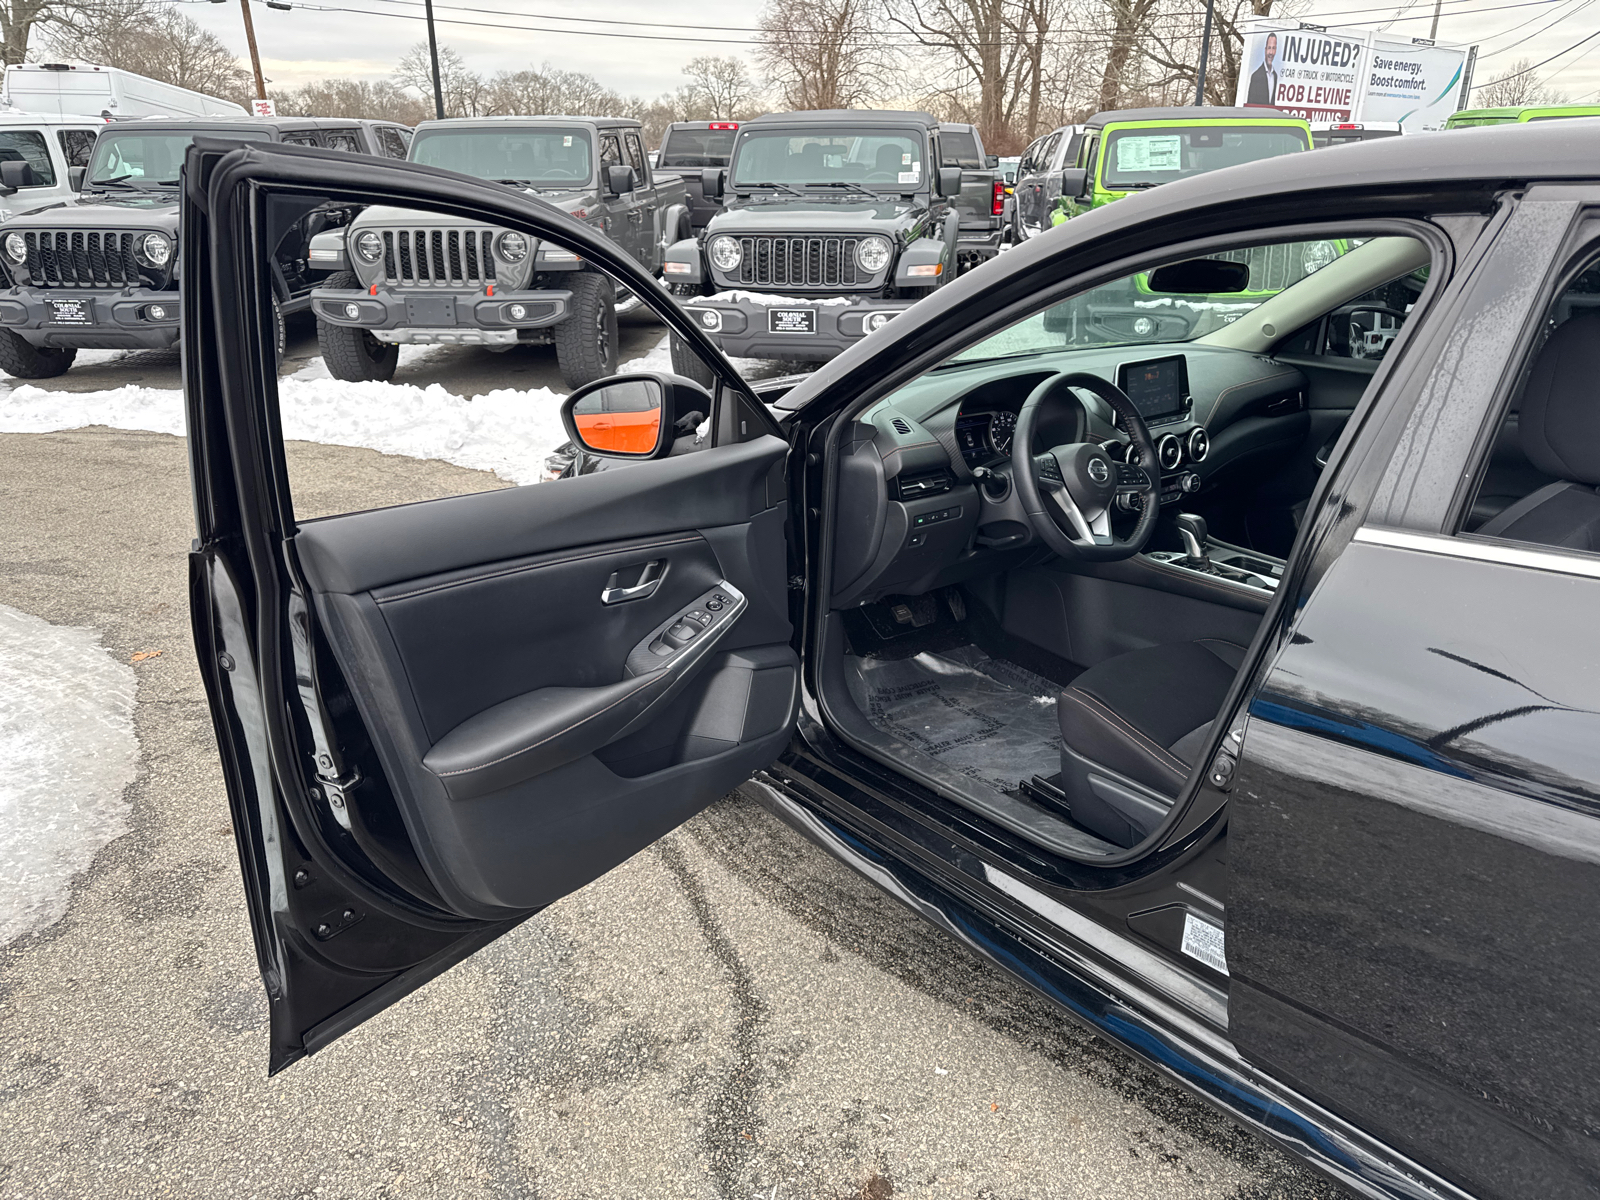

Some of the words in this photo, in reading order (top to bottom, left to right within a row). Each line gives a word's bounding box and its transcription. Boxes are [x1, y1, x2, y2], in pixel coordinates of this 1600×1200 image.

[1282, 35, 1360, 69] INJURED?
[1373, 55, 1393, 70] Save
[1394, 60, 1423, 76] energy.
[1285, 68, 1296, 78] CAR
[1302, 70, 1319, 80] TRUCK
[1325, 72, 1354, 84] MOTORCYCLE
[1370, 73, 1394, 88] Boost
[1394, 77, 1427, 91] comfort.
[1277, 83, 1305, 103] ROB
[1307, 85, 1352, 106] LEVINE
[954, 733, 975, 744] MUST
